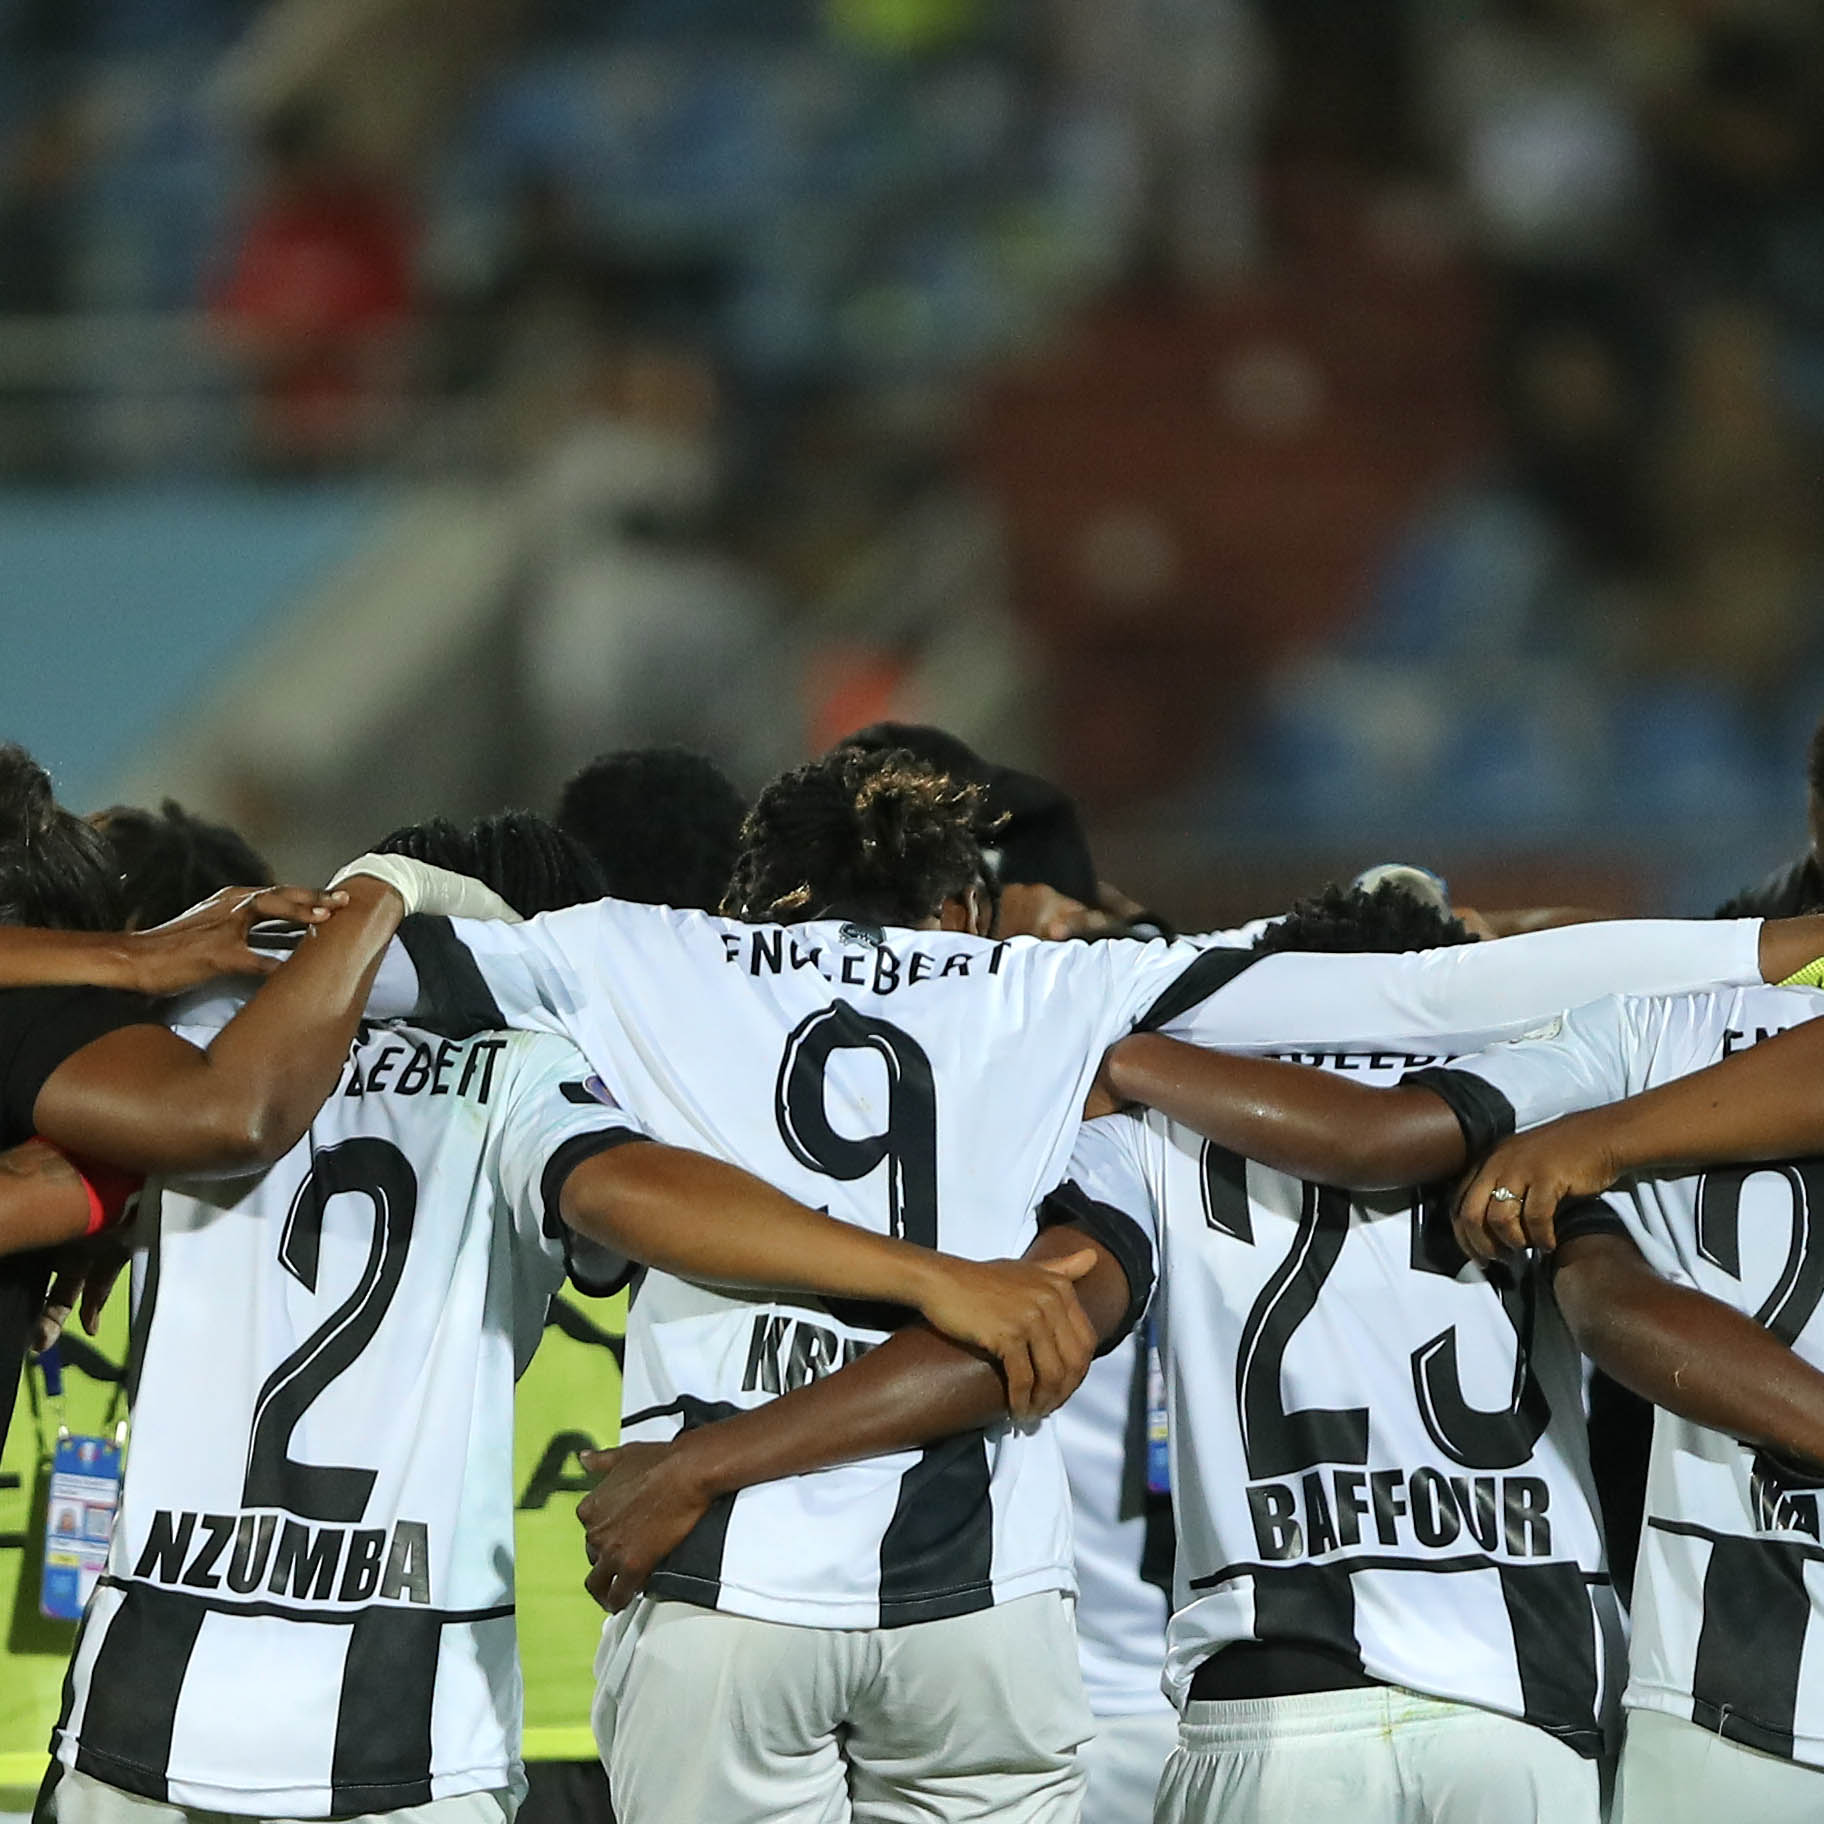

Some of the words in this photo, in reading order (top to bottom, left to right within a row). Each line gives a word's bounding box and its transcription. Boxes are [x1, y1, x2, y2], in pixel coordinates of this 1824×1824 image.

[776, 999, 936, 1326] 9
[1199, 1138, 1552, 1481] 25
[241, 1136, 418, 1523] 2
[134, 1510, 431, 1605] NZUMBA
[1246, 1465, 1553, 1561] BAFFOUR
